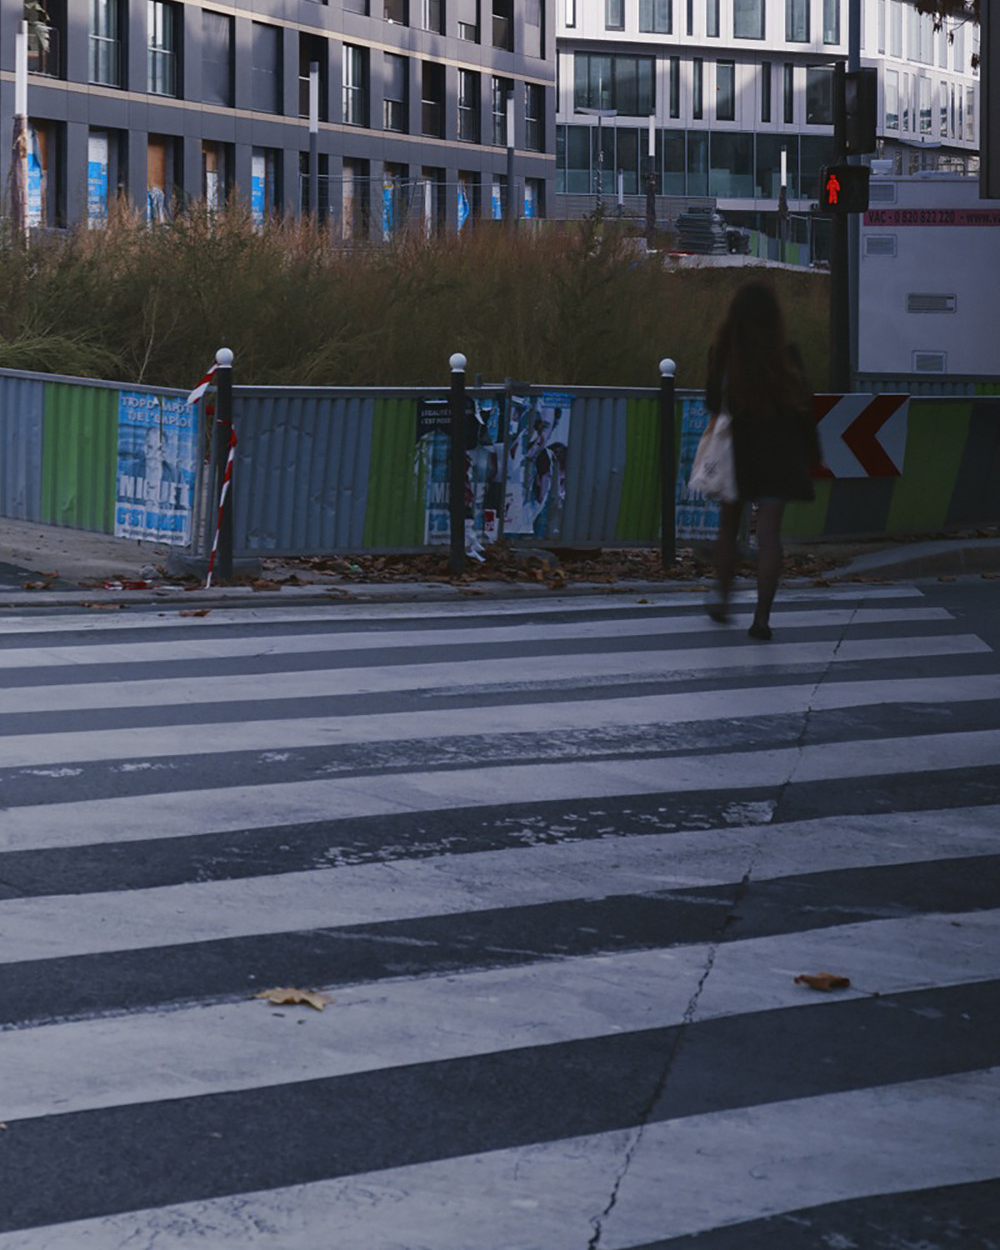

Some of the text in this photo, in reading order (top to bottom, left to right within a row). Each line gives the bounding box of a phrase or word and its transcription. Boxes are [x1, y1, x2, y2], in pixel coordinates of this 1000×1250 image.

[867, 211, 886, 223] VAC
[902, 211, 918, 223] 820
[921, 211, 936, 223] 822
[939, 211, 955, 223] 220
